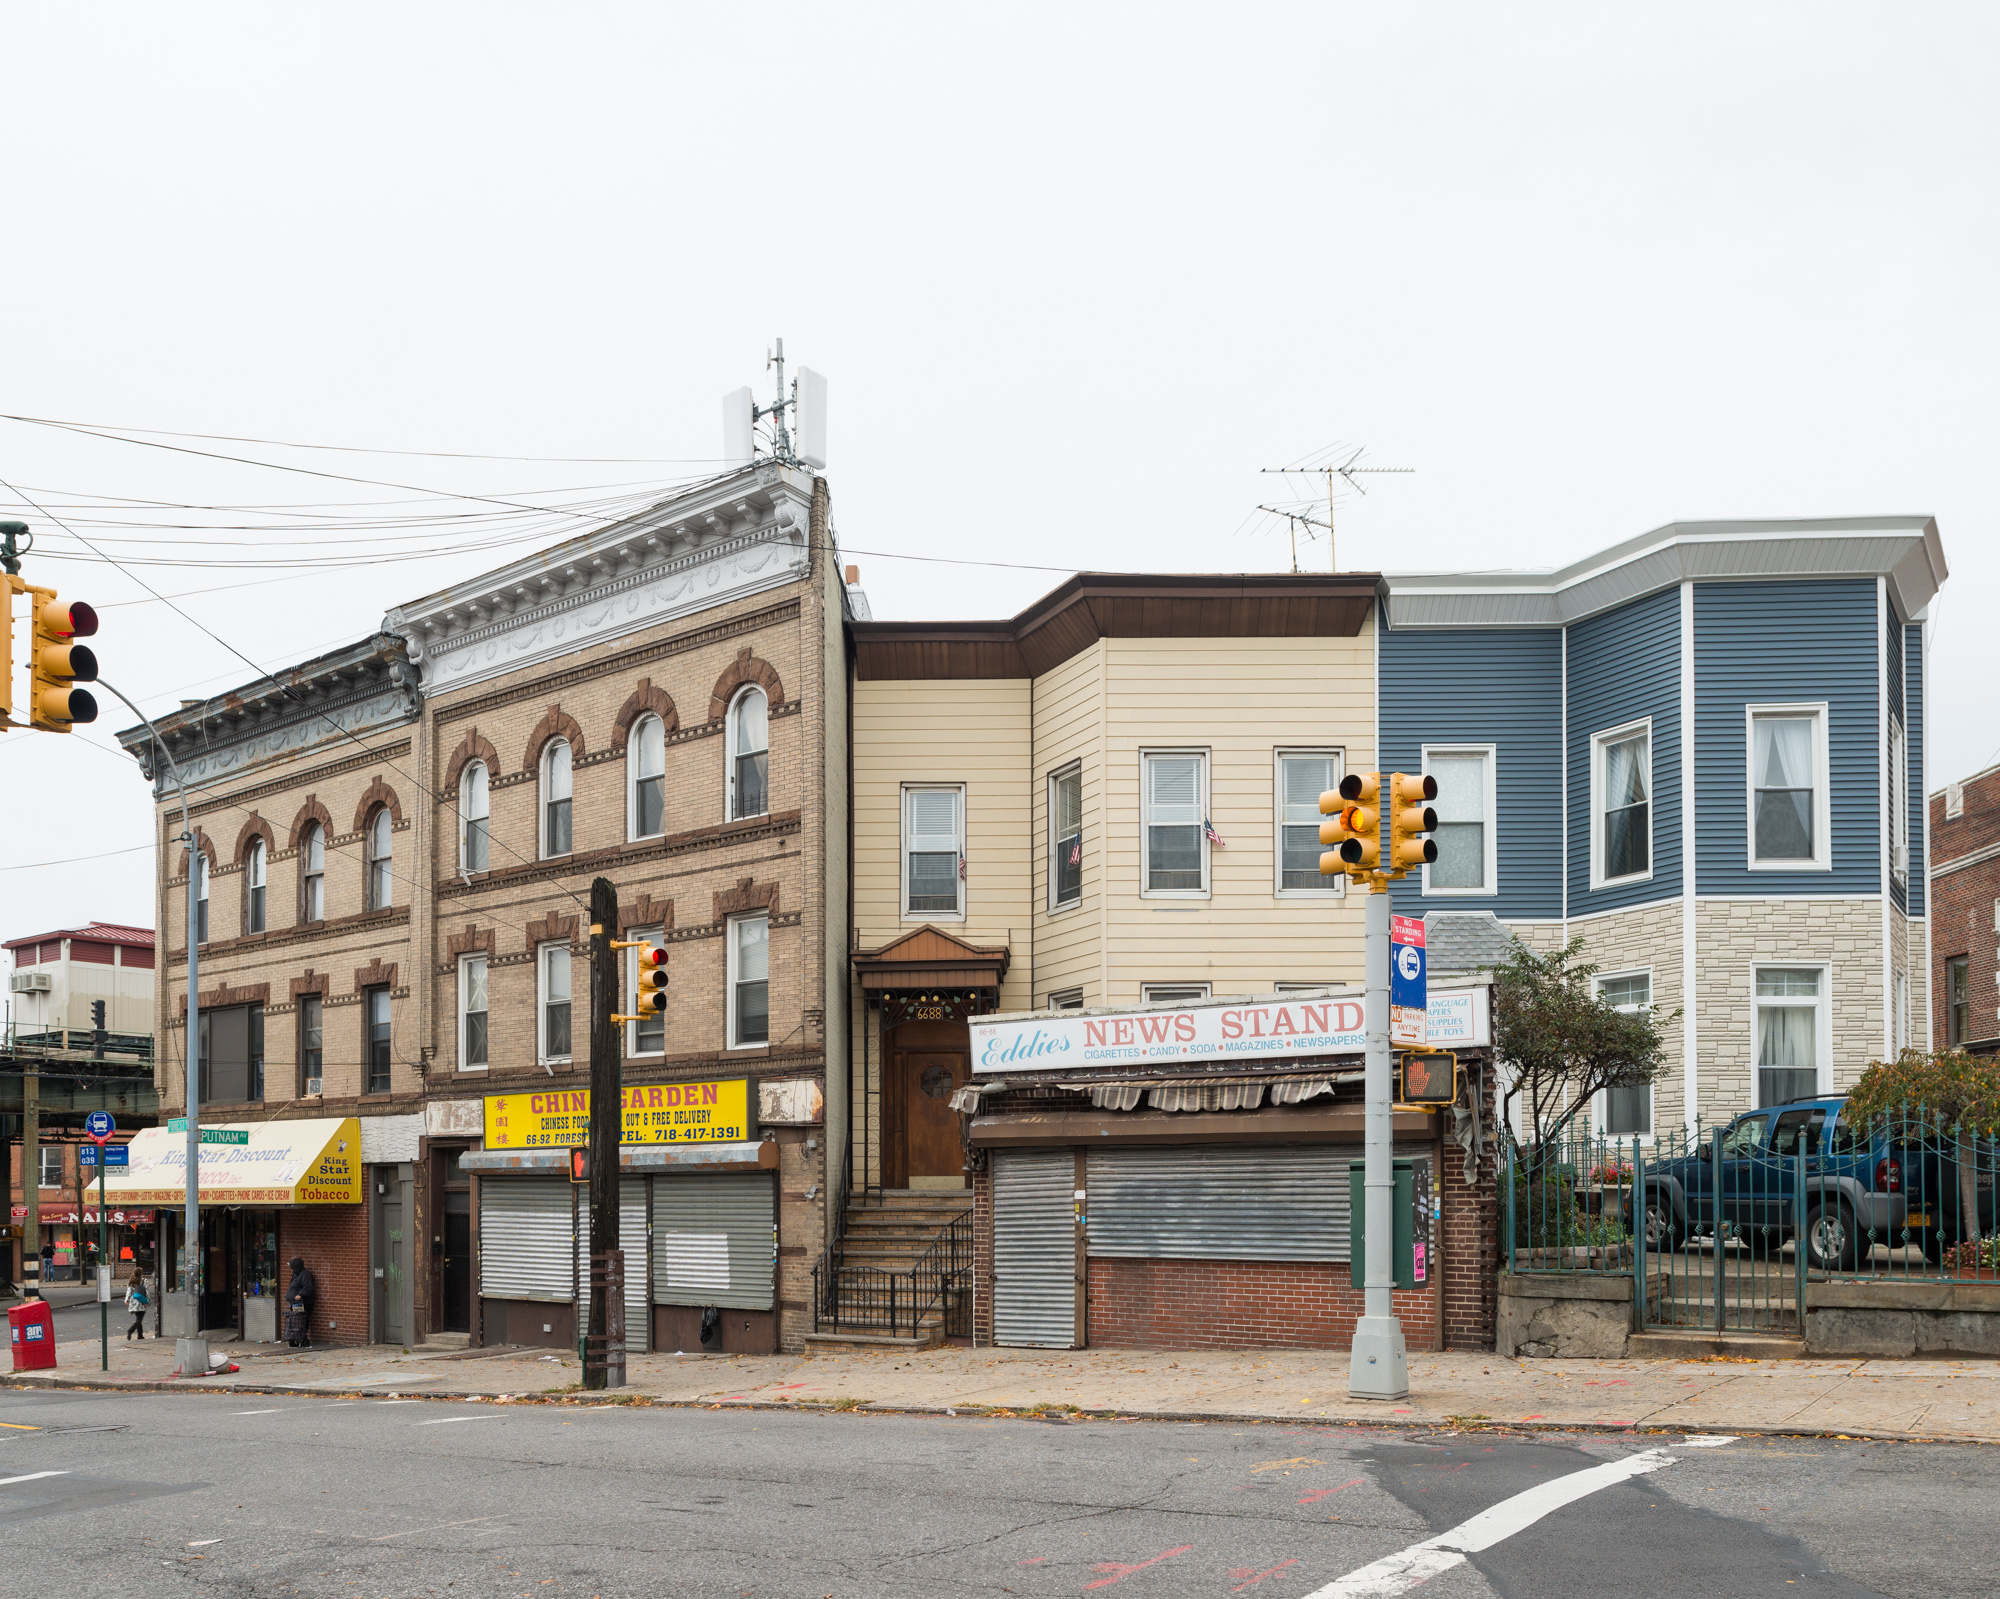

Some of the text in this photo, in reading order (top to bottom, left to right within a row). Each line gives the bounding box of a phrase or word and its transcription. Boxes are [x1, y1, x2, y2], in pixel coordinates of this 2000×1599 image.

[1404, 919, 1412, 927] NO
[1395, 925, 1422, 938] STANDING
[1431, 999, 1469, 1007] ANGUAGE
[917, 1008, 942, 1020] 6688
[1083, 1002, 1365, 1047] NEWS STAND
[1397, 1024, 1421, 1033] ANYTIME
[981, 1030, 1070, 1066] Eddies
[1084, 1034, 1365, 1060] CIGARETTES CANDY SODA MAGAZINES NEWSPAPERS
[531, 1092, 588, 1114] CHIN
[541, 1116, 569, 1130] CHINESE
[626, 1112, 640, 1126] OUT
[643, 1112, 648, 1126] &
[652, 1111, 671, 1125] FREE
[674, 1109, 712, 1124] DELIVERY
[201, 1131, 239, 1143] PUTNAM
[526, 1126, 741, 1145] 66-92 FOREST TEL: 718-417-1391
[224, 1147, 291, 1164] Discount
[324, 1156, 347, 1166] King
[320, 1165, 349, 1174] Star
[308, 1175, 352, 1185] Discount
[275, 1190, 290, 1200] CREAM
[300, 1187, 350, 1200] Tobacco
